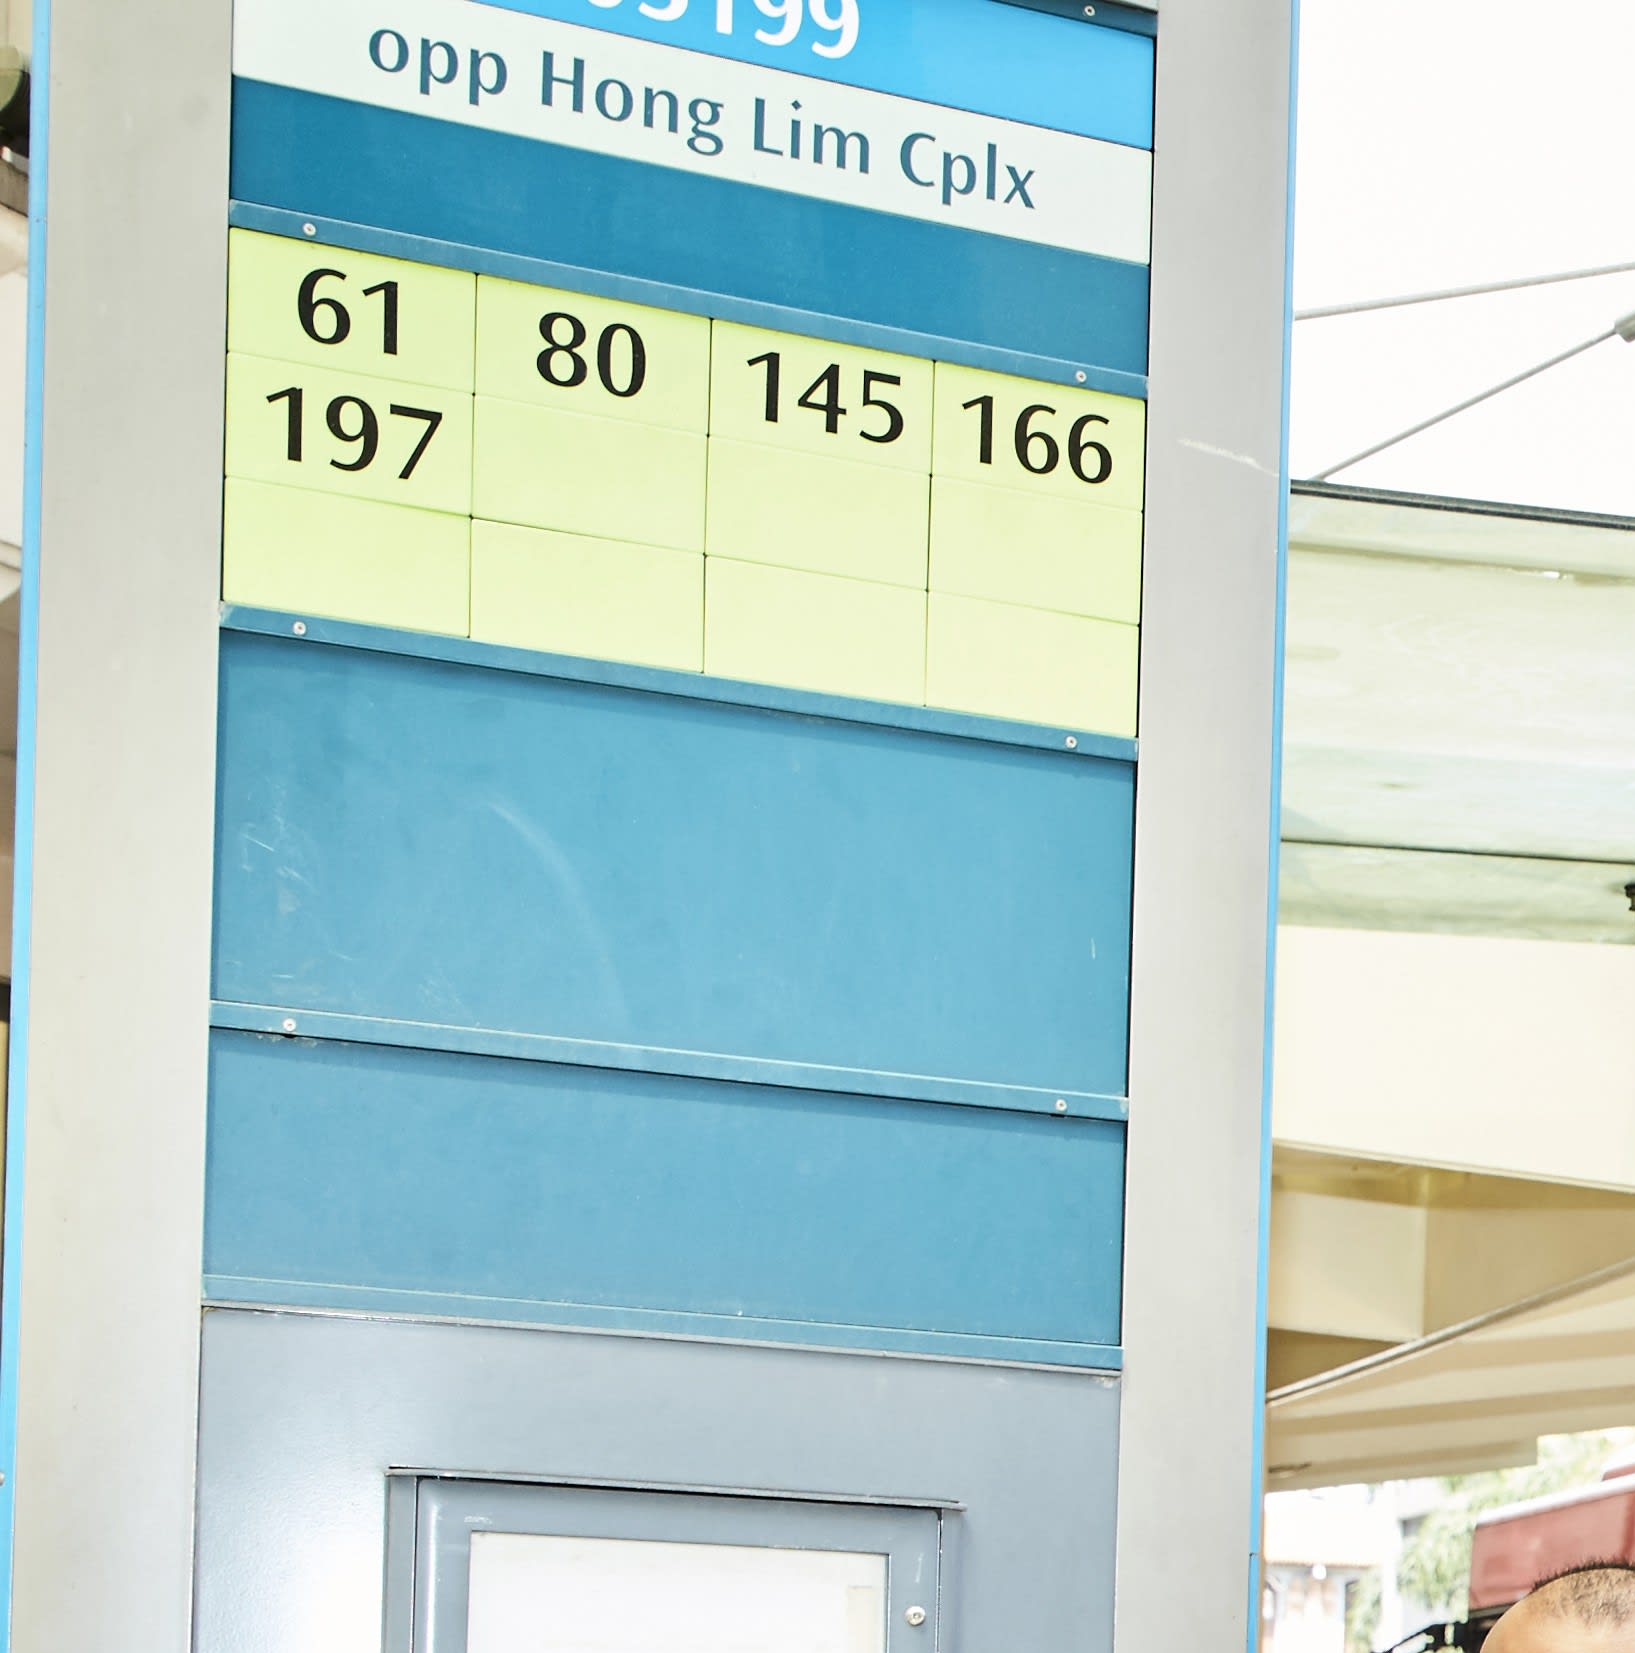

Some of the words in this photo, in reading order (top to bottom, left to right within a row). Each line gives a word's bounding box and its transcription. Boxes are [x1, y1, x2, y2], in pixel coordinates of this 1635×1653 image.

[369, 29, 508, 106] opp
[541, 50, 724, 156] Hong
[753, 97, 870, 175] Lim
[900, 132, 1036, 210] Cplx
[265, 387, 443, 480] 197
[297, 268, 399, 356] 61
[536, 312, 647, 398] 80
[746, 352, 905, 444] 145
[961, 395, 1114, 485] 166
